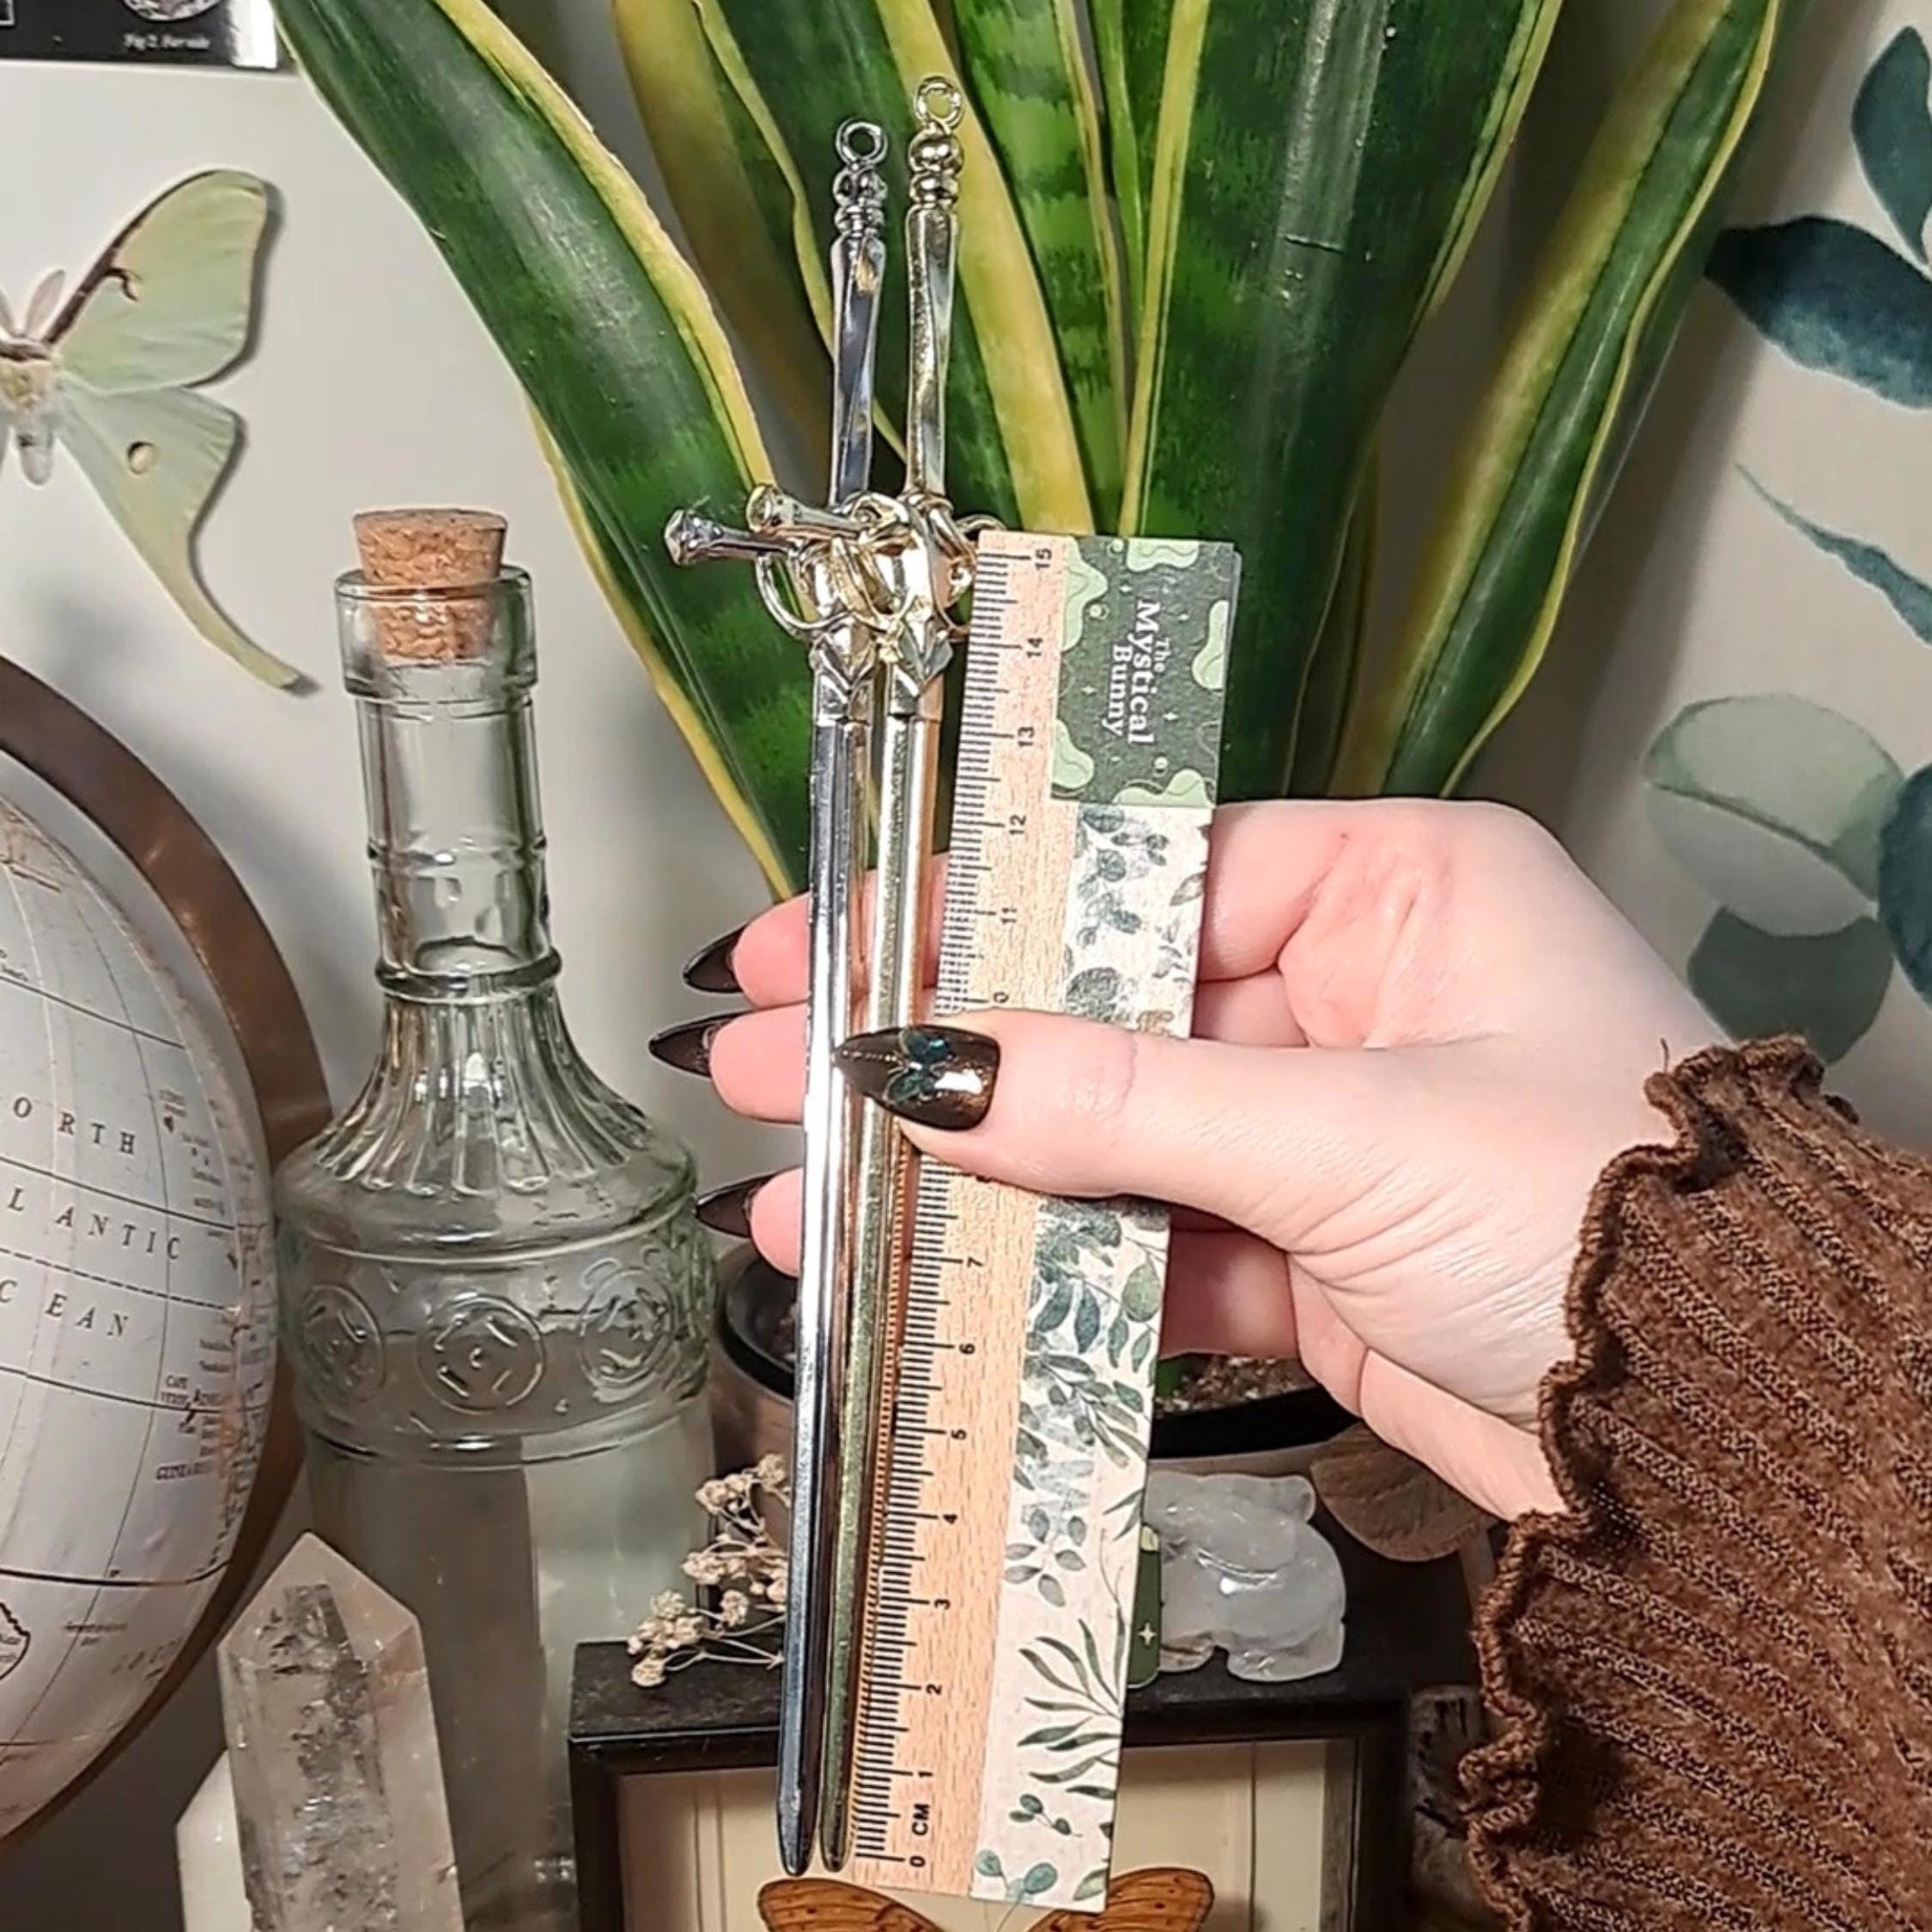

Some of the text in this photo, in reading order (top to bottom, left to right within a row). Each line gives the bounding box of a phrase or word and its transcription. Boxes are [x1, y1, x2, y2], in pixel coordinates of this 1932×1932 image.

[1035, 548, 1053, 570] 15
[1026, 637, 1043, 658] 14
[1154, 637, 1170, 673] The
[1127, 600, 1160, 744] Mystical
[1102, 645, 1132, 737] Bunny
[1018, 726, 1035, 748] 13
[1009, 814, 1027, 835] 12
[1001, 907, 1018, 925] 11
[967, 1257, 983, 1269] 7
[958, 1342, 976, 1355] 6
[951, 1428, 968, 1440] 5
[942, 1513, 958, 1525] 4
[933, 1598, 951, 1610] 3
[926, 1683, 943, 1696] 2
[917, 1771, 934, 1779] 1
[911, 1803, 931, 1836] CM
[908, 1855, 926, 1868] 0
